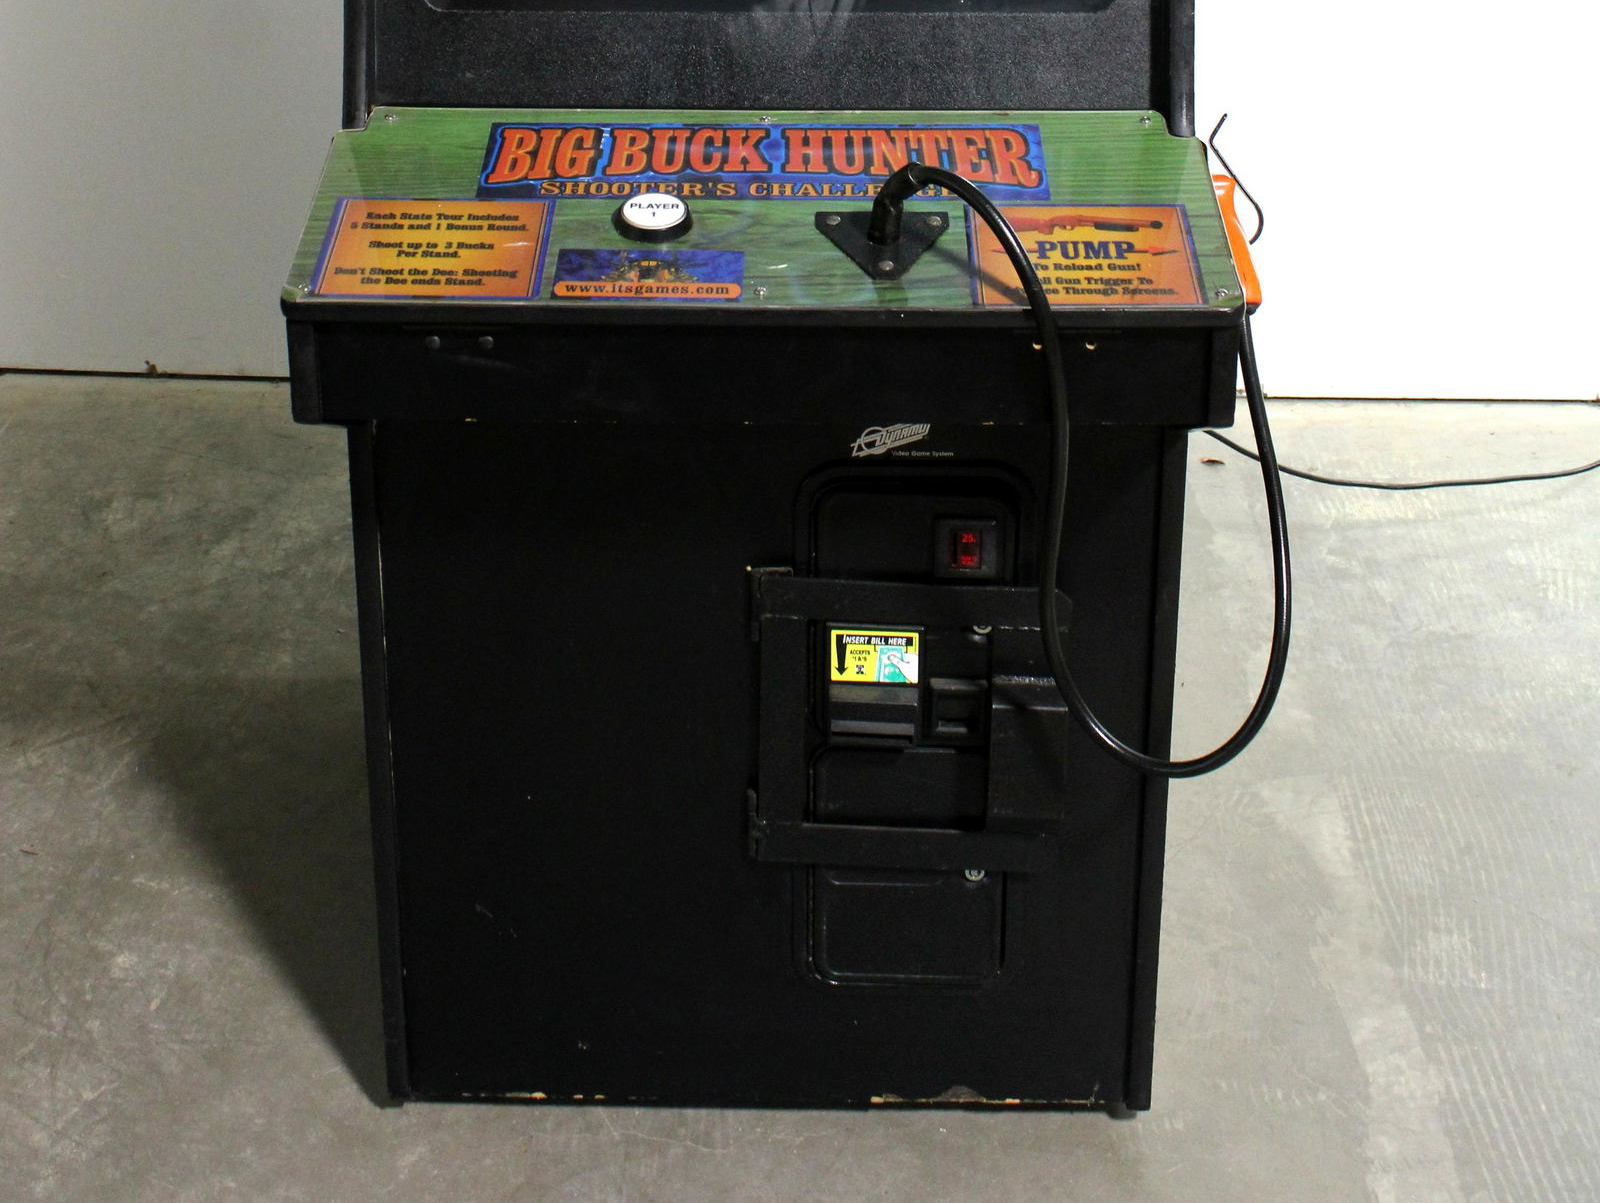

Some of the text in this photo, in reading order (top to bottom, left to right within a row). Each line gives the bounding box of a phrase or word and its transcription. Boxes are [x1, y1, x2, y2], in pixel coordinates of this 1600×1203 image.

[487, 127, 1039, 188] BIG BUCK HUNTER
[540, 181, 736, 196] SHOOTER'S
[366, 212, 519, 222] Each State Tour Includes
[361, 222, 404, 230] Stands
[407, 222, 431, 230] and
[446, 223, 483, 231] Bonus
[486, 223, 529, 232] Round.
[369, 240, 404, 249] Shoot
[407, 241, 422, 251] up
[426, 241, 438, 249] to
[456, 241, 495, 250] Bucks
[1035, 240, 1136, 260] PUMP
[397, 250, 461, 259] Per Stand.
[1053, 263, 1103, 271] Reload
[1107, 263, 1141, 271] Gun!
[334, 267, 518, 279] Don't Shoot the Doe: Shooting
[361, 277, 485, 286] the Doe ends Stand.
[1055, 277, 1081, 285] Gun
[1085, 277, 1135, 287] Trigger
[565, 283, 730, 296] www.itsgames.com
[1062, 287, 1118, 296] Through
[843, 634, 907, 646] INSERT BILL HERE
